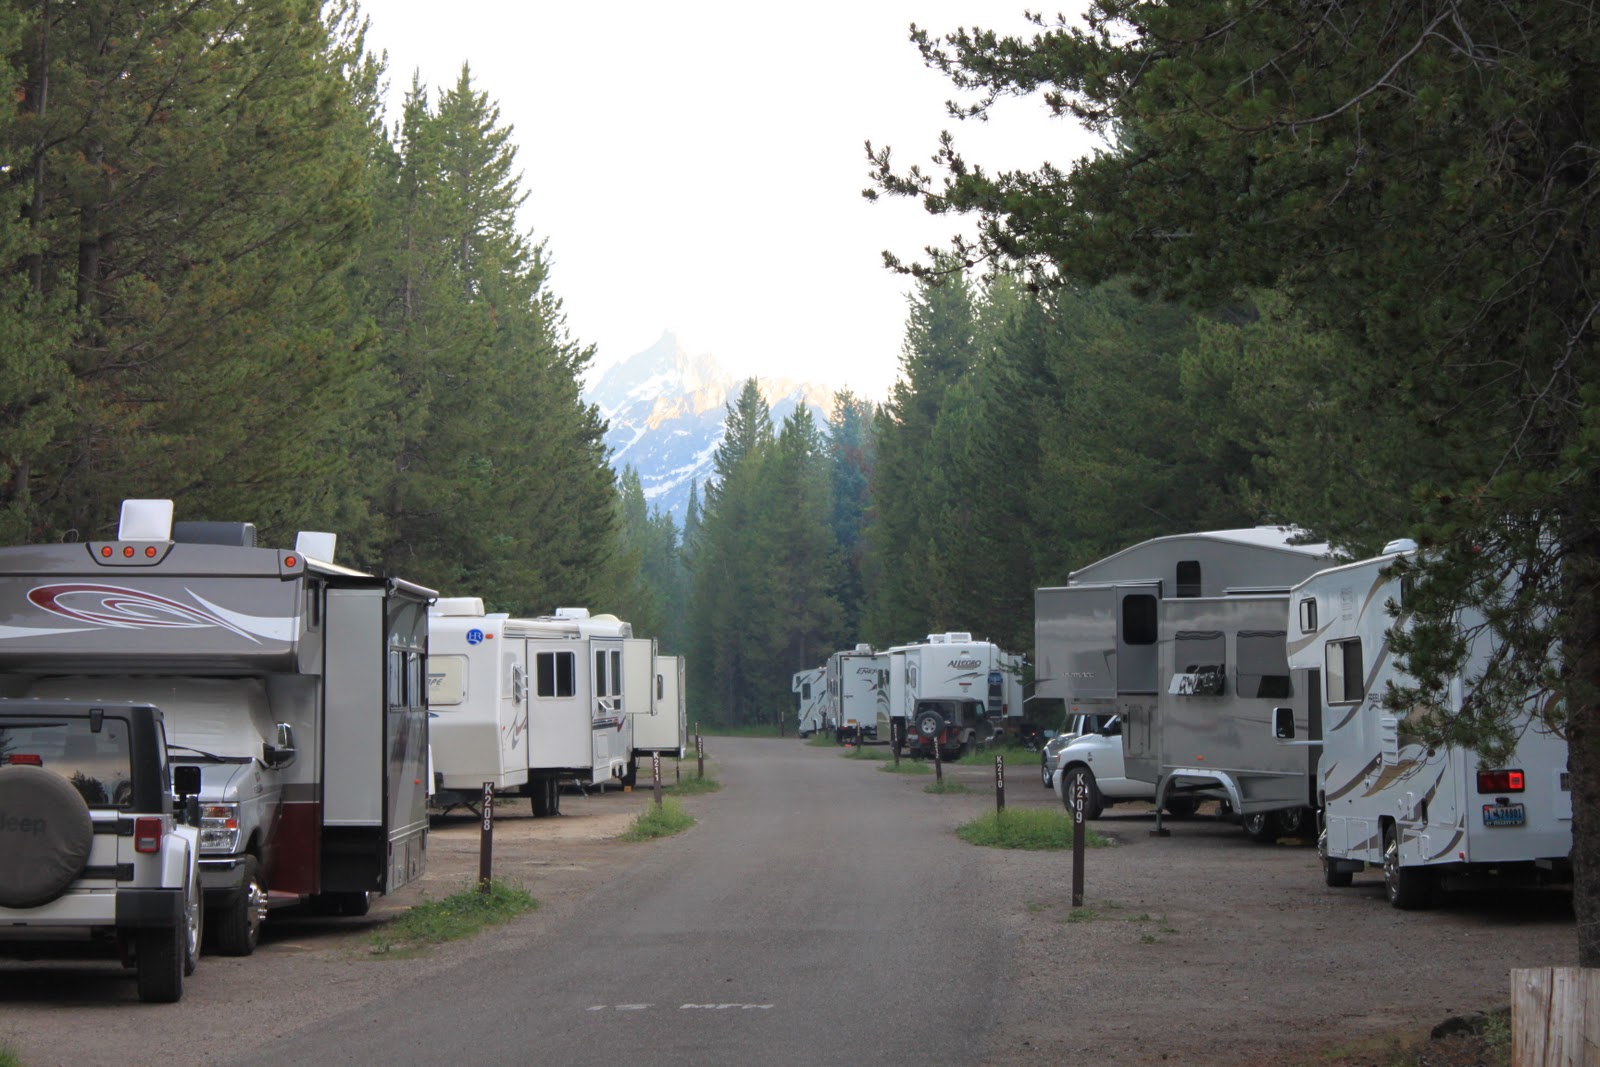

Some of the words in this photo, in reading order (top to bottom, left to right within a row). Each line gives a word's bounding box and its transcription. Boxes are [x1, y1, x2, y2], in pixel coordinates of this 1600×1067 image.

[947, 659, 982, 669] ALLEGRO
[483, 783, 493, 831] K208
[1076, 773, 1084, 824] K209
